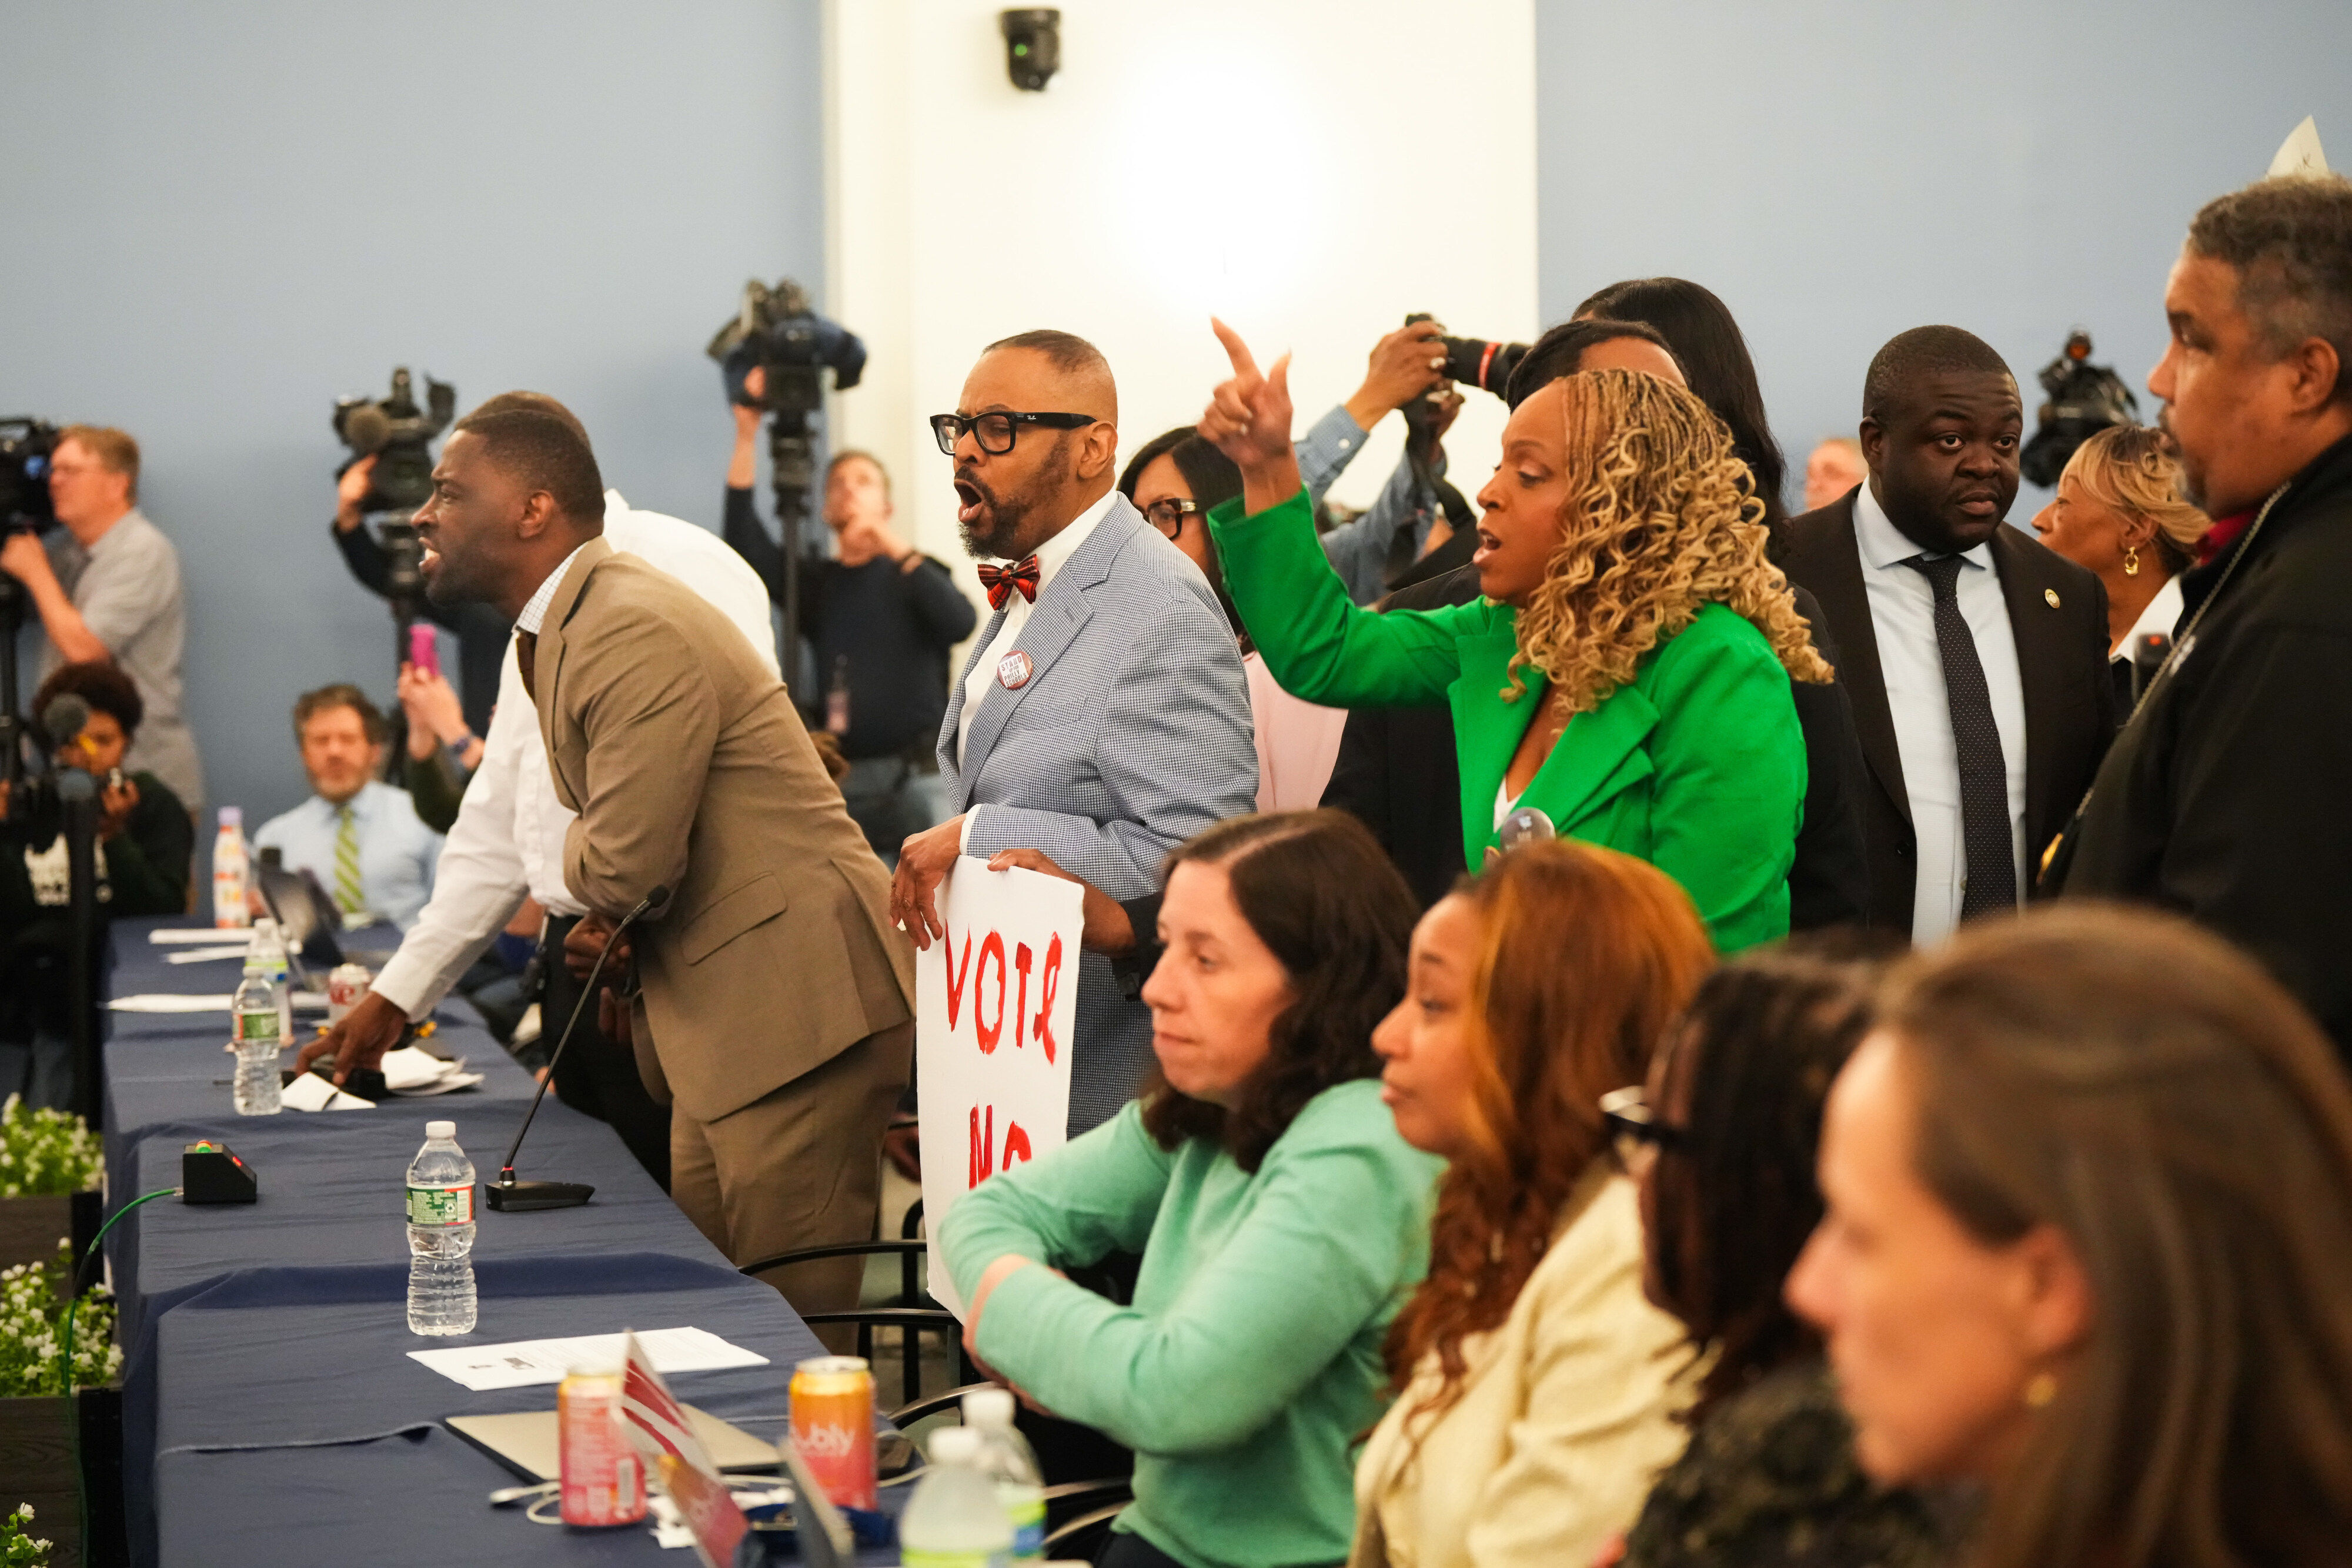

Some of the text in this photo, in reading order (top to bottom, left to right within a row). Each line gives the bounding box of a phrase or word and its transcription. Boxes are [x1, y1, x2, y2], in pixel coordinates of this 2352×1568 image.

[1001, 656, 1022, 671] STAND
[1004, 670, 1020, 681] PHILLY
[1006, 673, 1027, 687] SCHOOLS
